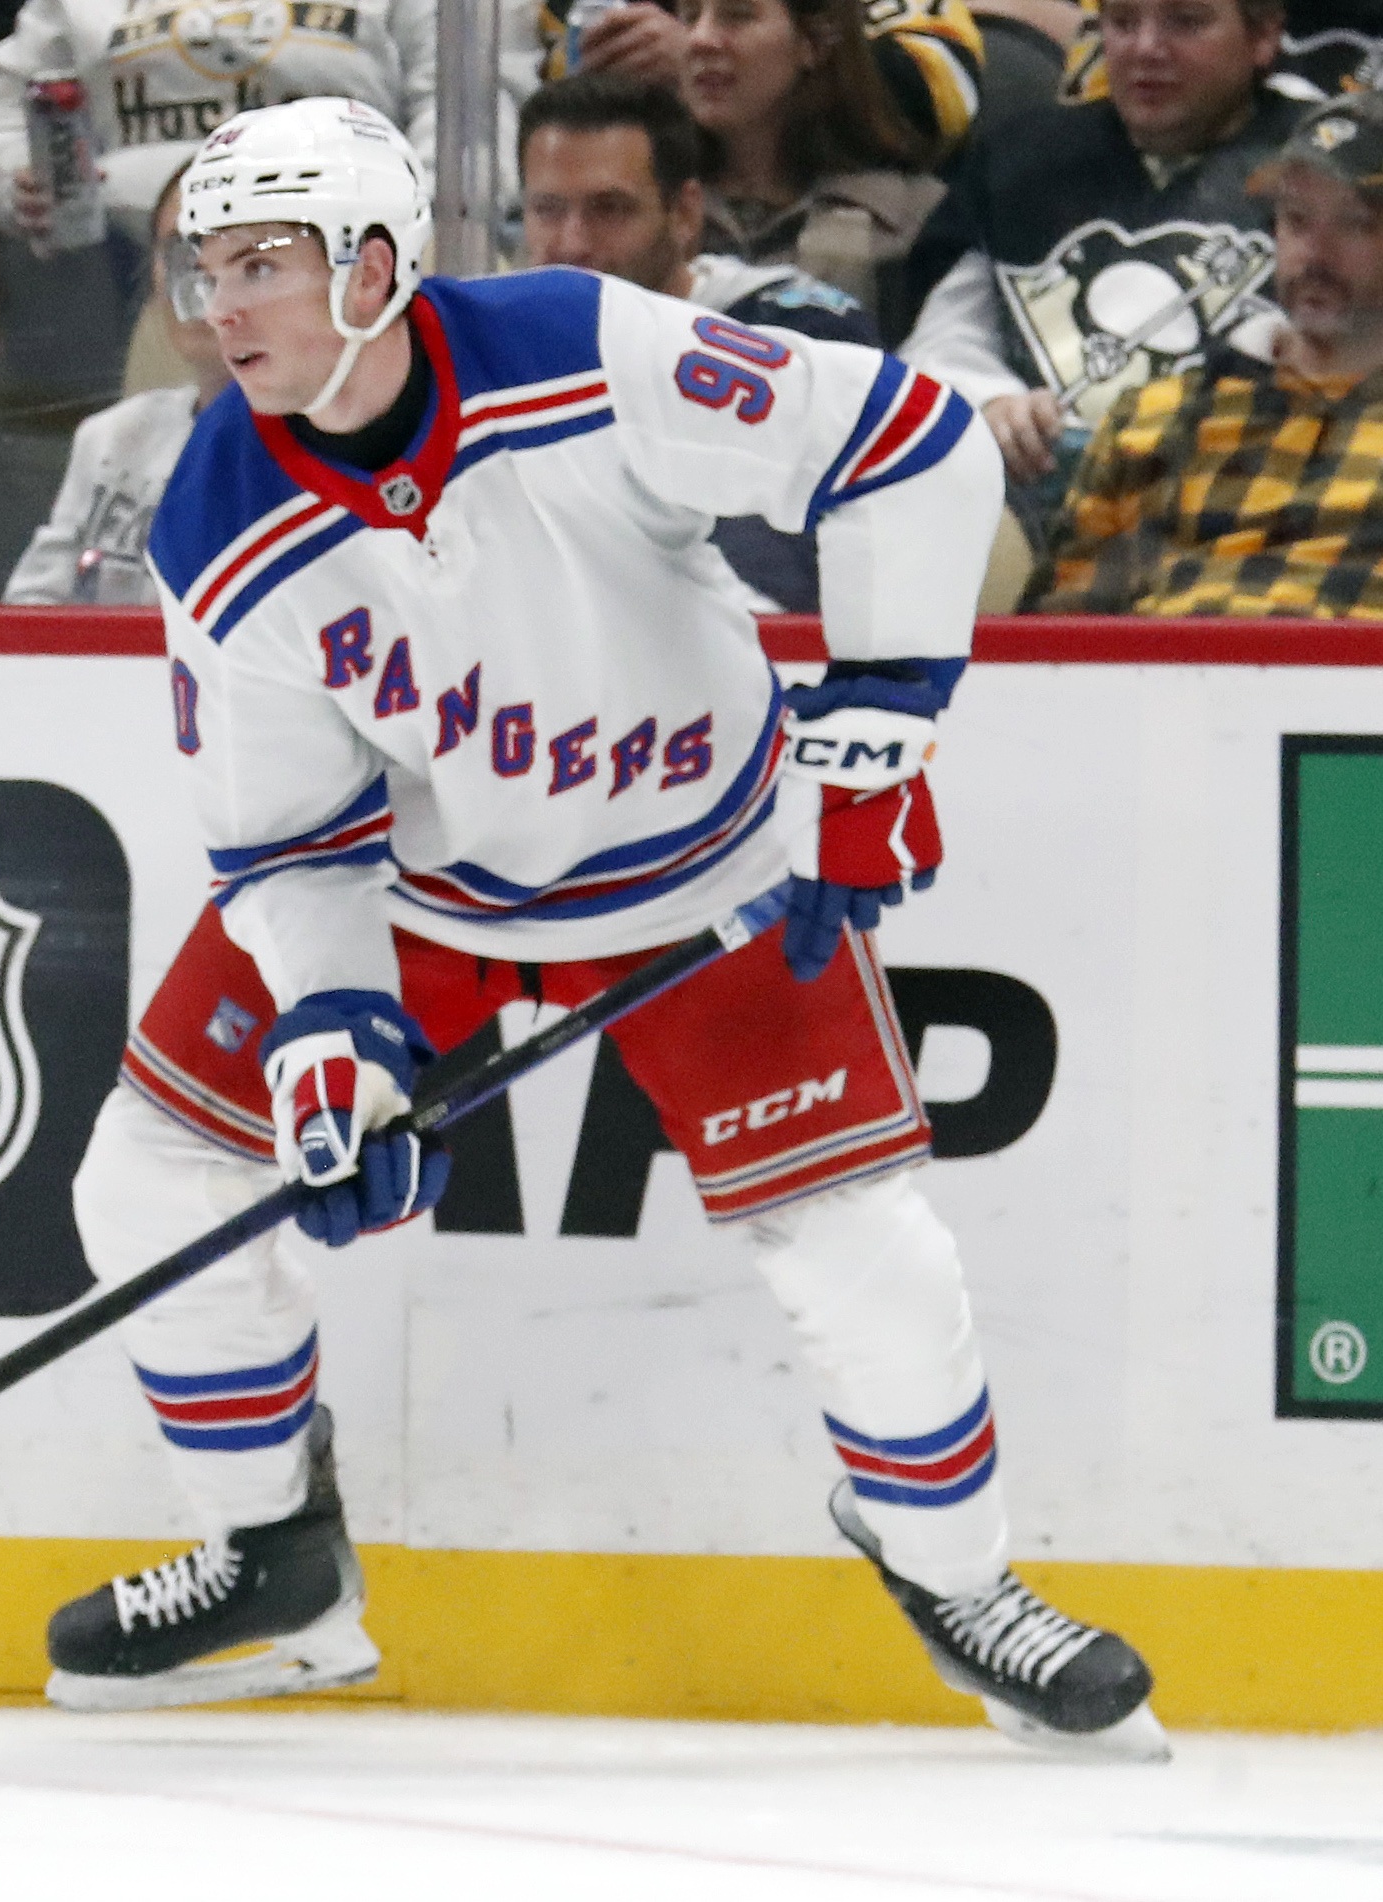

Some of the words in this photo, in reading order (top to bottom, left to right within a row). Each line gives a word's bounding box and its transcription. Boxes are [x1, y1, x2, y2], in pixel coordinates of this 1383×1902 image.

[674, 316, 793, 425] 90
[320, 606, 713, 800] RANGERS
[785, 734, 905, 769] CM
[700, 1068, 848, 1146] CCM
